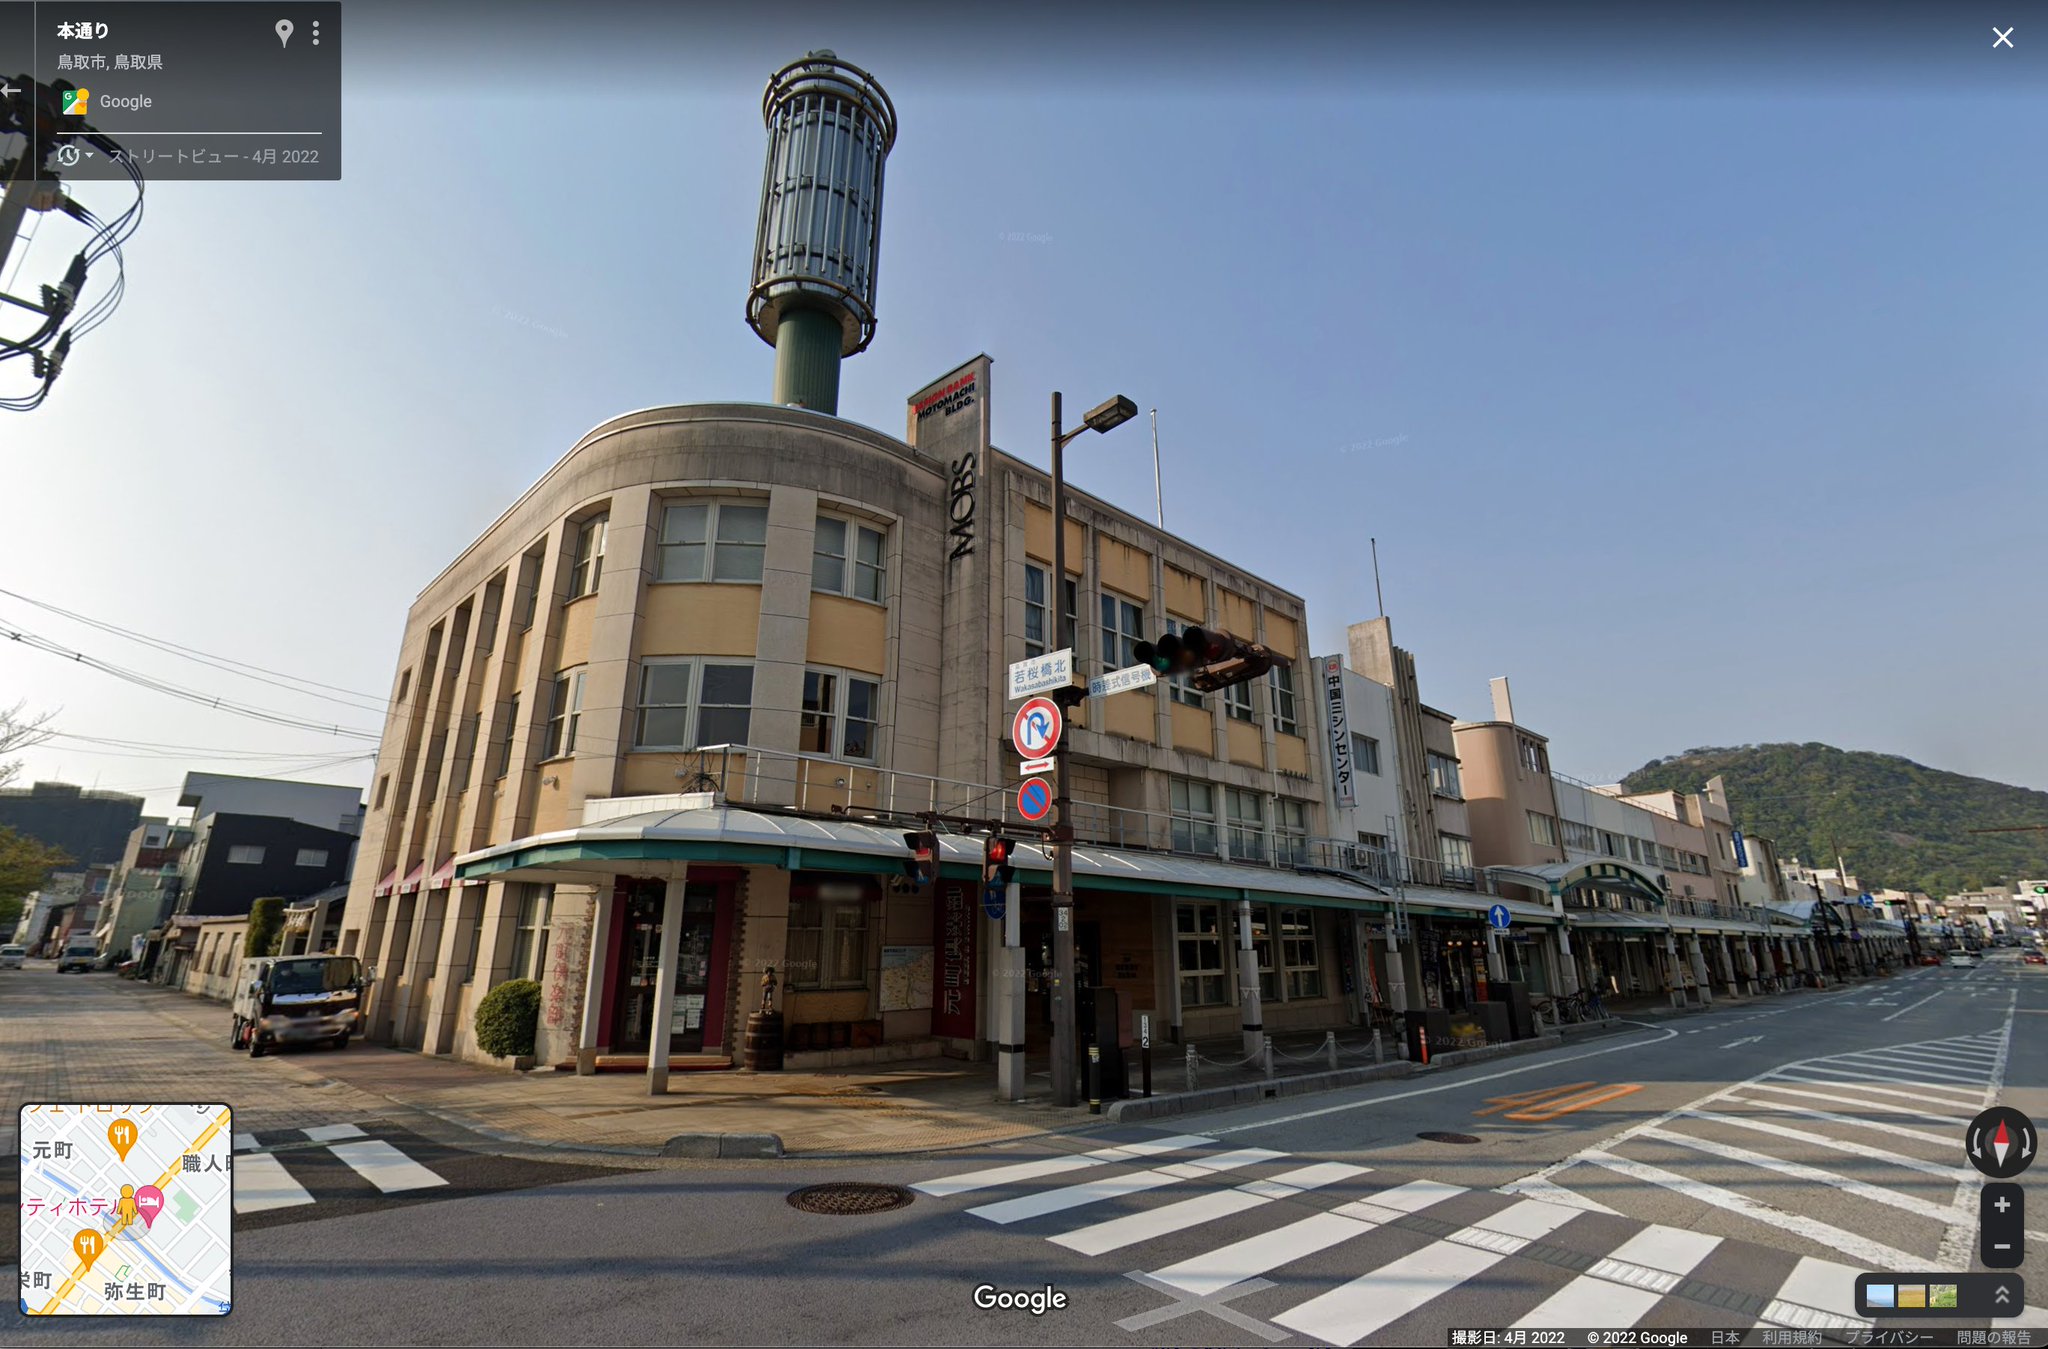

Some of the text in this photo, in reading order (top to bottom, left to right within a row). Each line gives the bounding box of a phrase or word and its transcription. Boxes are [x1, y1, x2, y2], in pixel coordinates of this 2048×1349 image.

[947, 371, 976, 393] BANK
[917, 382, 975, 422] MOTOMACHI
[945, 396, 975, 416] BLDG.
[949, 451, 977, 562] MOBS
[1014, 659, 1066, 684] 若桜橋北
[1014, 675, 1066, 693] Wakasabashikita
[1091, 669, 1152, 694] 時差式信号機
[1327, 674, 1351, 796] 中国ミシンセンター
[1142, 1036, 1149, 1047] 2
